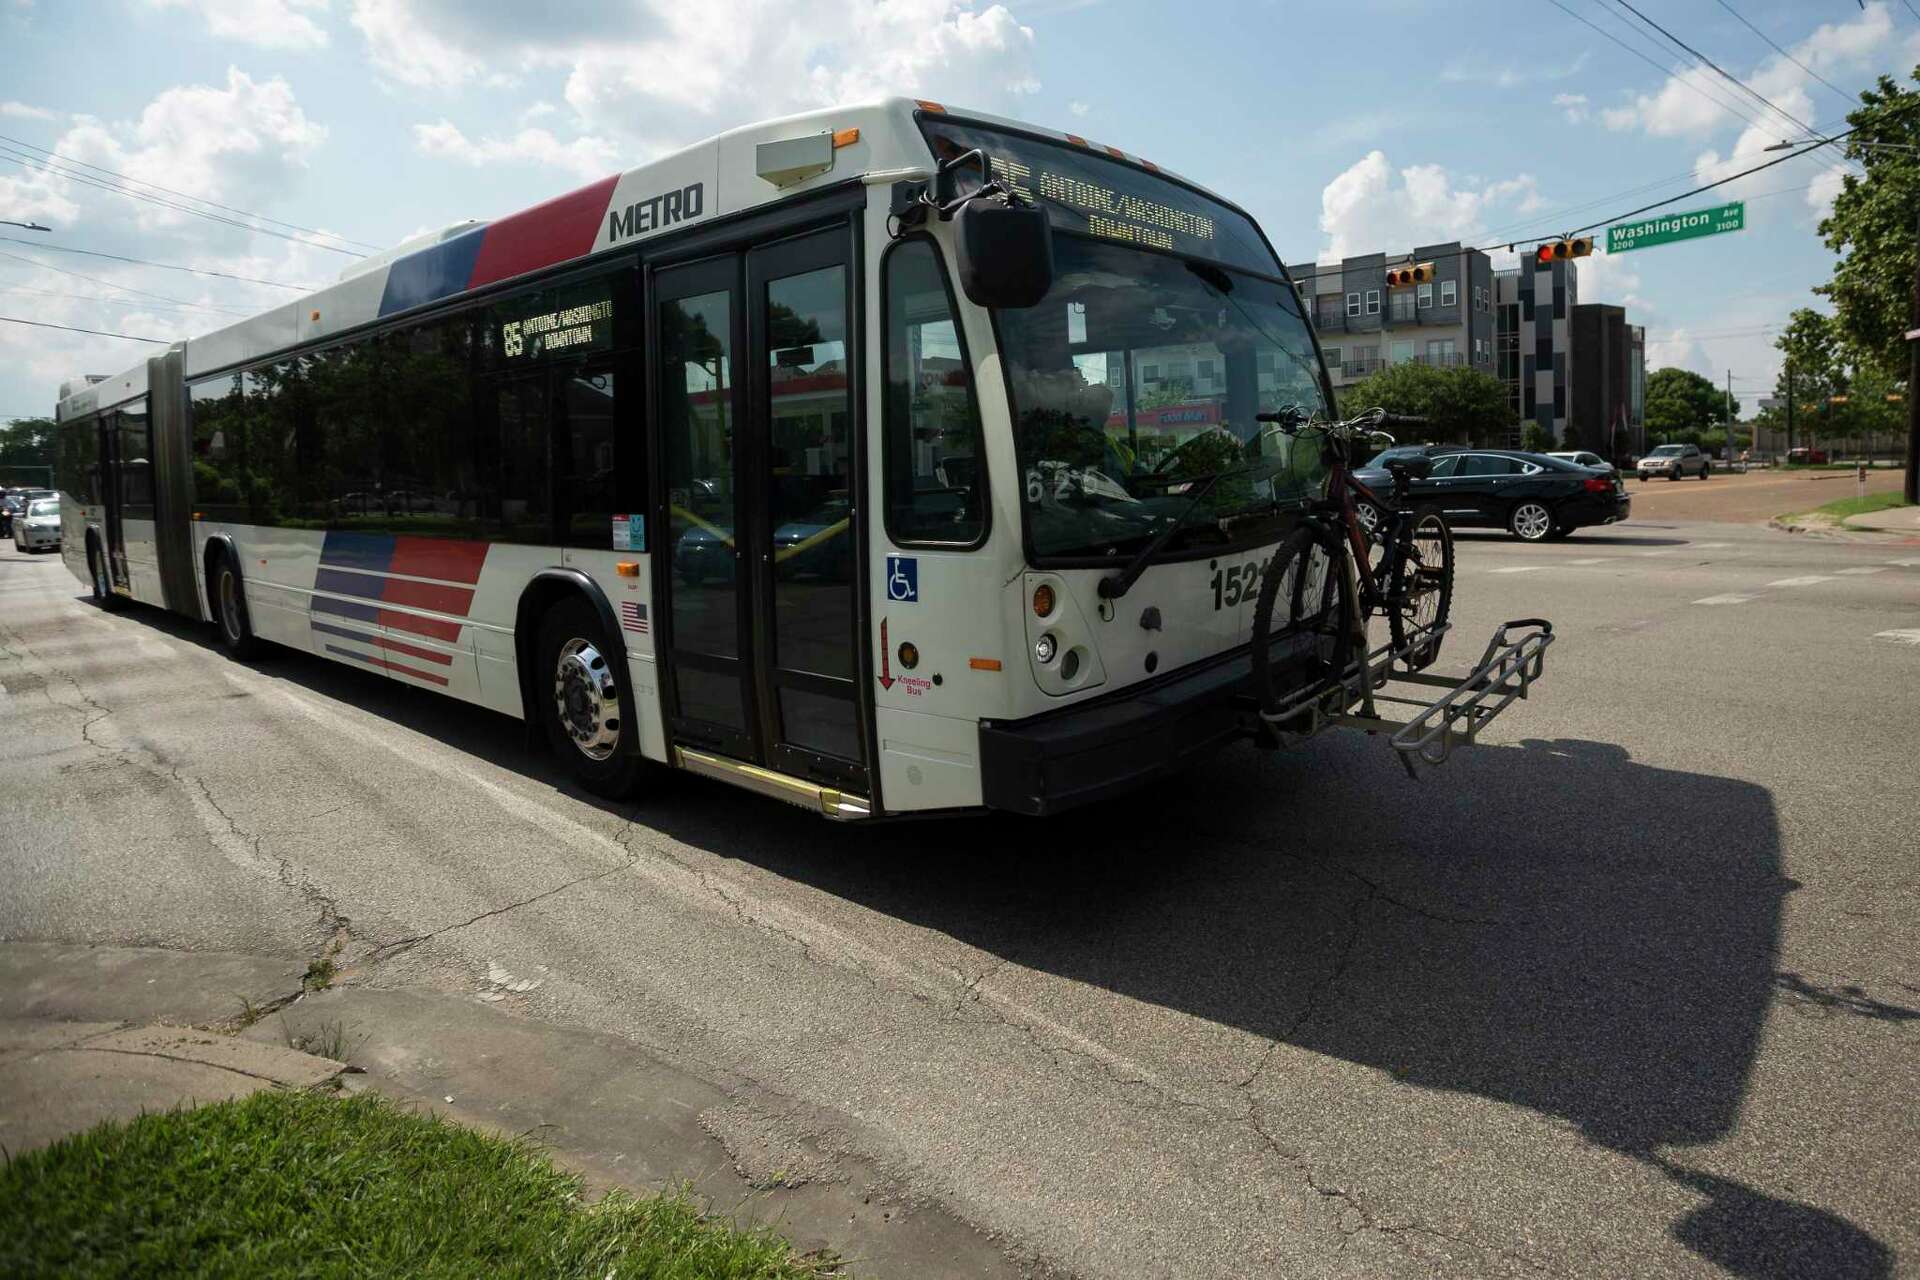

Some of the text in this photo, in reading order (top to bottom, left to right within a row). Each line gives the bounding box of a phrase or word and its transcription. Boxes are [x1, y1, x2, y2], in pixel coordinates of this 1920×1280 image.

[609, 182, 703, 243] METRO
[1039, 171, 1214, 240] ANTOINE/WASHINGTON
[1088, 214, 1173, 250] DOWNTOWN
[1612, 207, 1739, 241] Washington Ave
[1716, 219, 1739, 232] 3100
[1612, 240, 1634, 251] 3200
[503, 321, 523, 357] 85
[544, 325, 592, 350] DOWNTOWN
[896, 674, 931, 689] Kneeling
[906, 685, 922, 696] Bus
